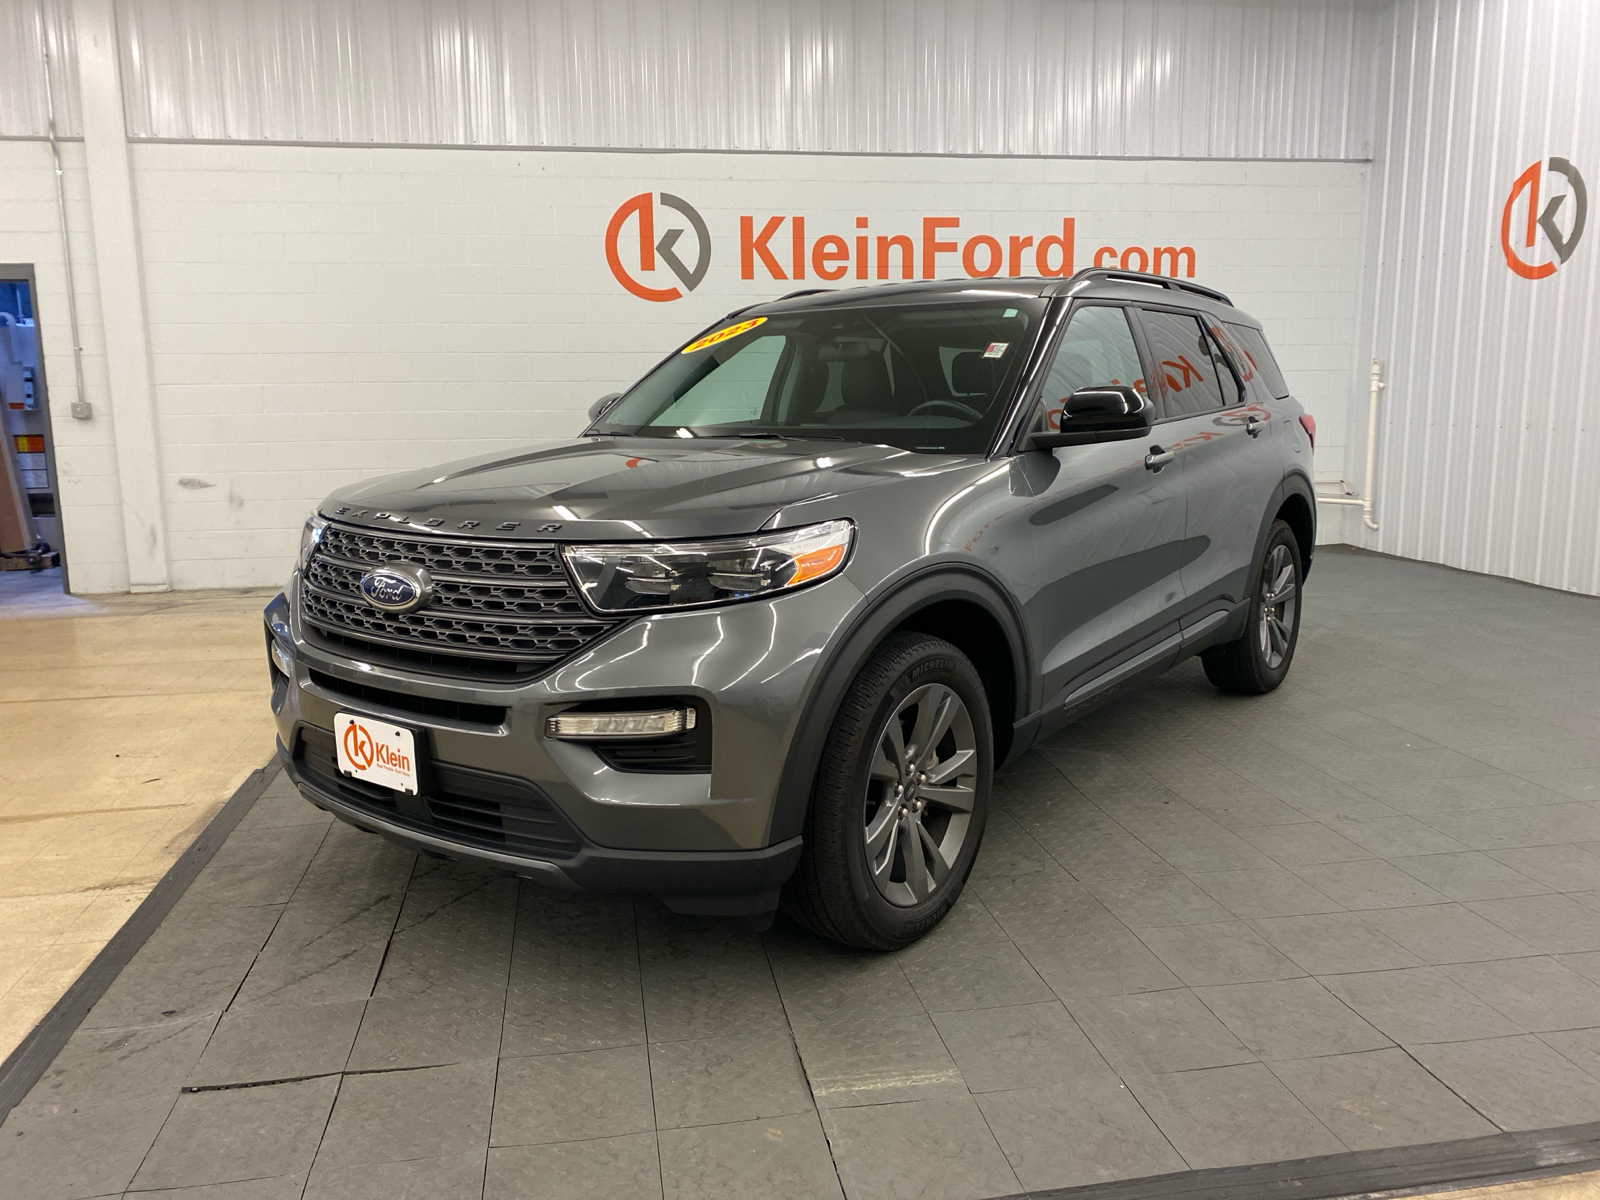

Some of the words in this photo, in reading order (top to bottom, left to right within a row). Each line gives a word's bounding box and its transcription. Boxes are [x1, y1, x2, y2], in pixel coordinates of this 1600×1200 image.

[690, 319, 759, 352] 2023
[335, 506, 563, 533] EXPLORER
[371, 576, 411, 601] Ford
[912, 658, 955, 680] MICHELIN
[375, 742, 410, 772] Klein
